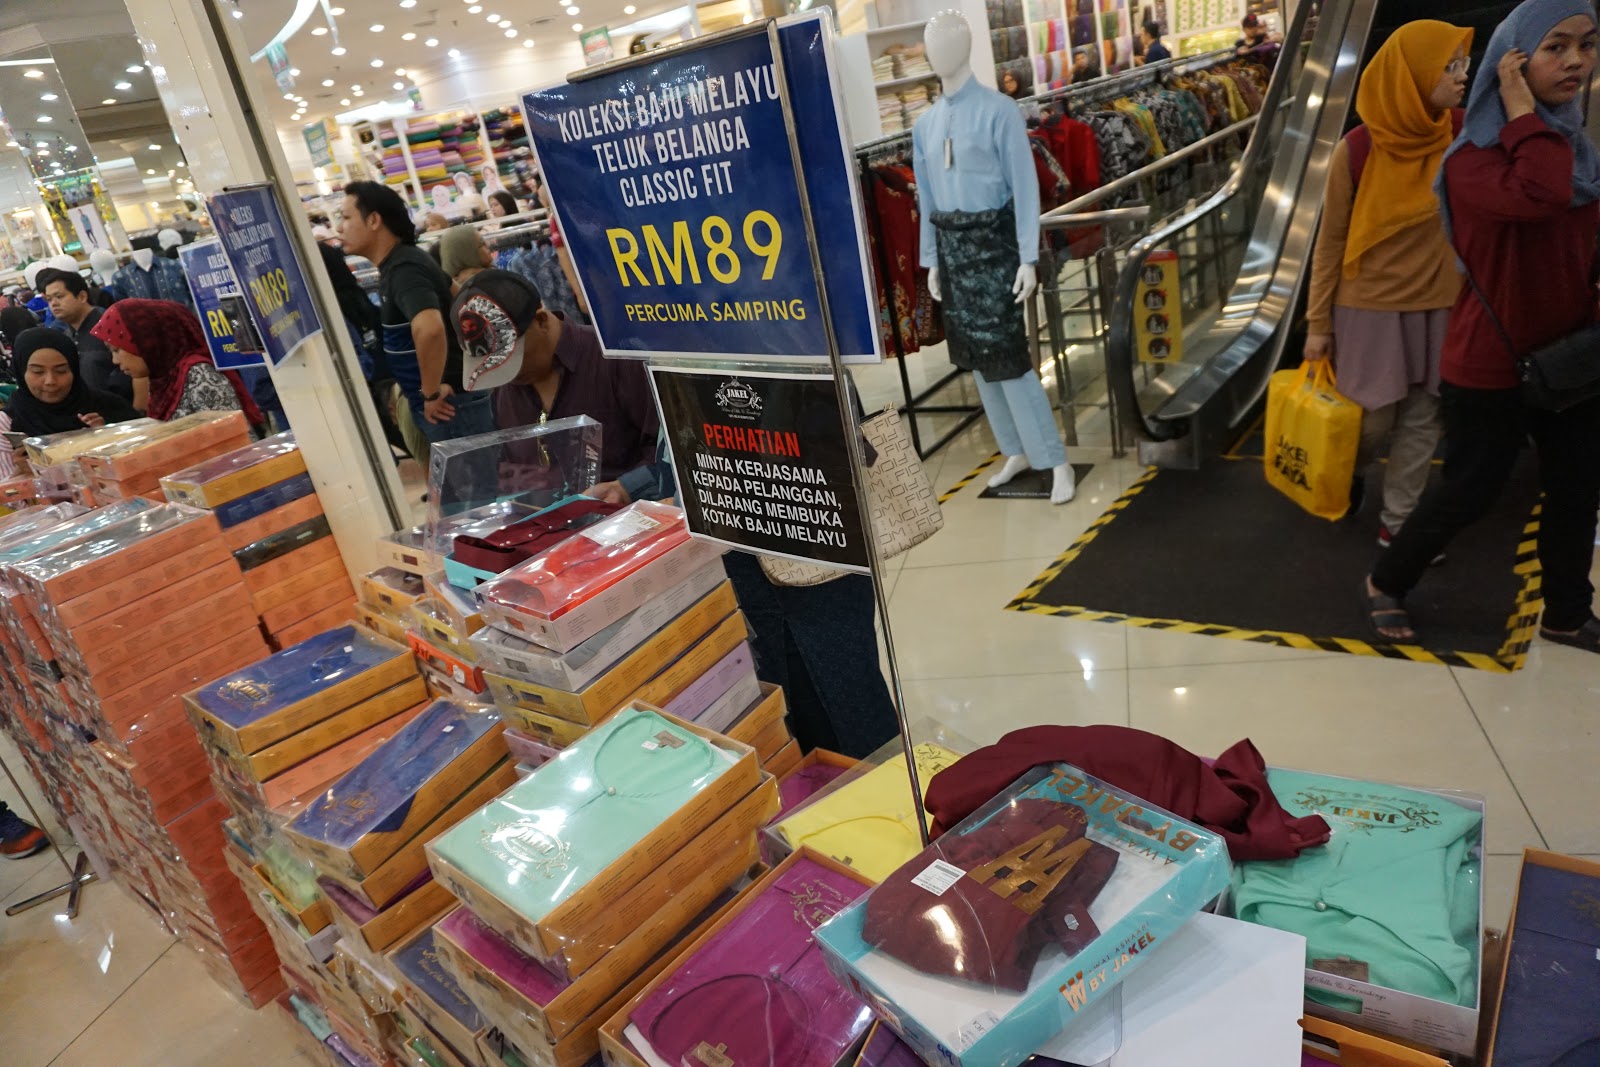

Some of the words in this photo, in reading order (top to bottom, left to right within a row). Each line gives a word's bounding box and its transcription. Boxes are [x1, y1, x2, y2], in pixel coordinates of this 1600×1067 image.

[557, 102, 632, 143] KOLEKSI
[637, 85, 684, 128] BAJU
[690, 63, 779, 117] MELAYU
[592, 140, 652, 174] TELUK
[654, 115, 750, 165] BELANGA
[619, 169, 698, 208] CLASSIC
[701, 161, 734, 197] FIT
[207, 253, 226, 269] KOLEK
[605, 210, 783, 287] RM89
[249, 267, 290, 319] RM89
[625, 303, 708, 322] PERCUMA
[711, 298, 806, 321] SAMPING
[727, 388, 749, 399] JAKEL
[703, 423, 801, 457] PERHATIAN
[695, 452, 732, 473] MINTA
[734, 459, 828, 486] KERJASAMA
[692, 470, 743, 493] KEPADA
[743, 479, 843, 510] PELANGGAN,
[698, 488, 763, 514] DILARANG
[766, 502, 844, 528] MEMBUKA
[701, 506, 744, 529] KOTAK
[745, 516, 782, 537] BAJU
[785, 523, 848, 548] MELAYU
[1046, 767, 1143, 822] JAKEL
[1330, 805, 1402, 824] JAKEL
[1147, 820, 1201, 852] BY
[1089, 968, 1106, 992] BY
[1113, 931, 1156, 973] JAKEL
